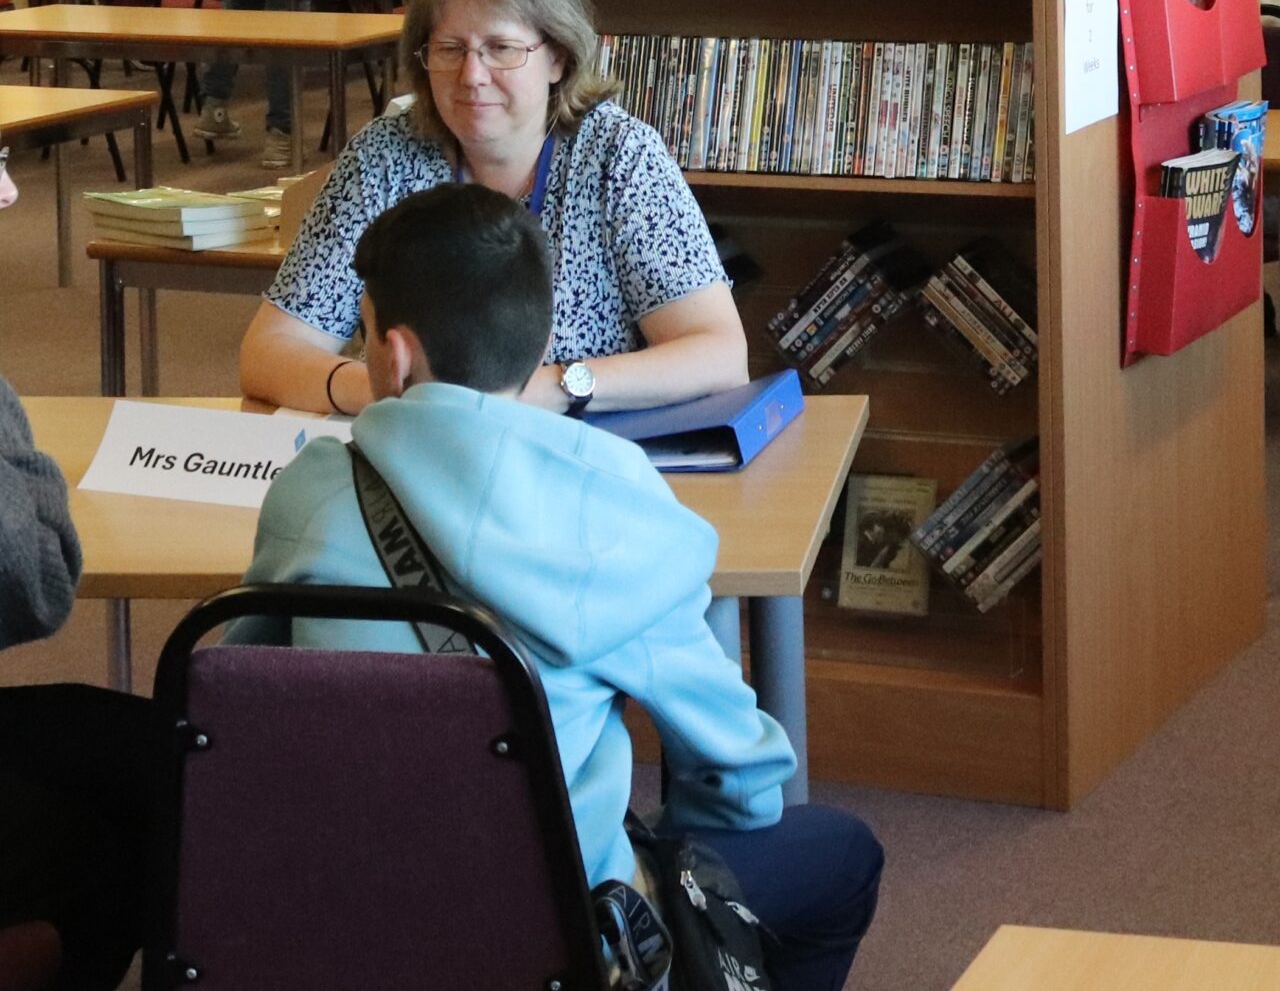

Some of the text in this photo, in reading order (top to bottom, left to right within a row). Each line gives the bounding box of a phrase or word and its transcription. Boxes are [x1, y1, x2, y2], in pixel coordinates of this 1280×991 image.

[1186, 166, 1229, 195] WHITE
[1185, 191, 1224, 220] DWARF
[129, 446, 284, 482] Mrs Gauntle
[844, 570, 862, 585] The
